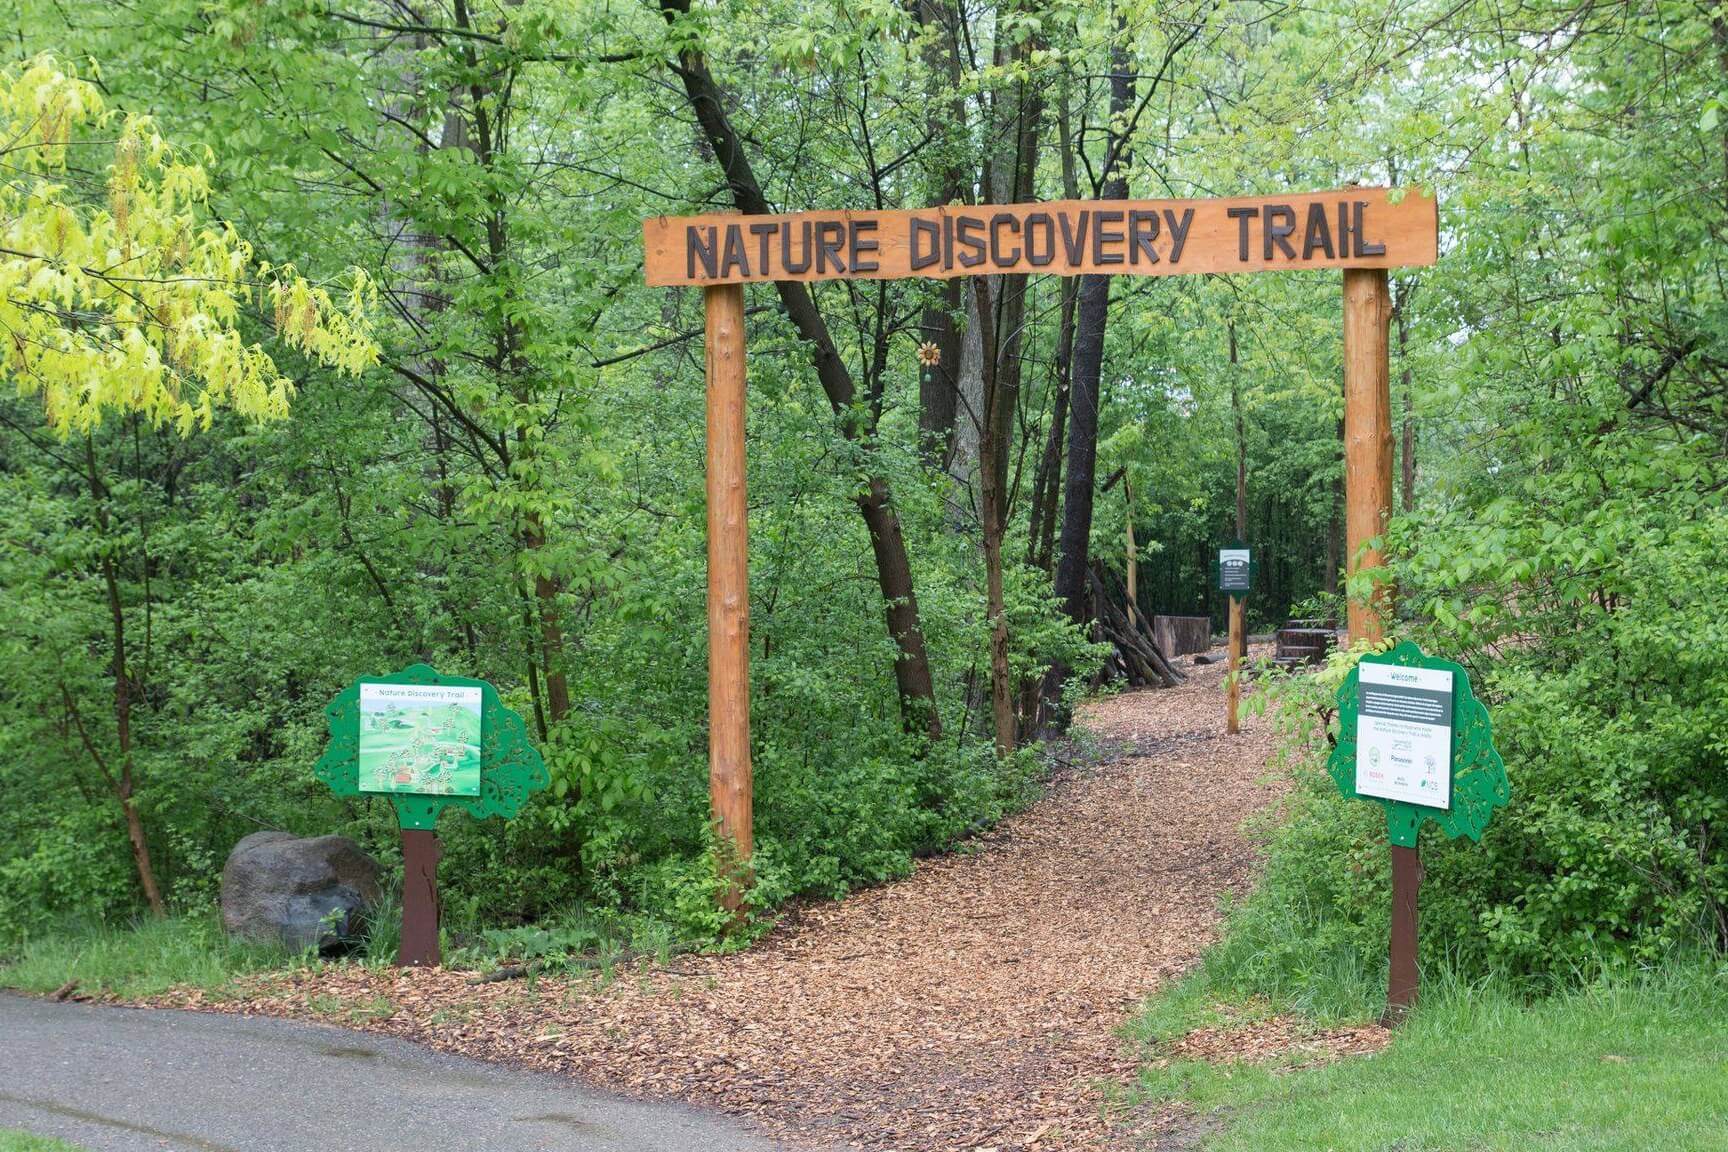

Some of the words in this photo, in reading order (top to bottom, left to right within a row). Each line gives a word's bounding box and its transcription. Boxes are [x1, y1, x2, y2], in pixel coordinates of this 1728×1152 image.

[686, 220, 880, 280] NATURE
[909, 207, 1195, 272] DISCOVERY
[1227, 201, 1386, 262] TRAIL
[1390, 672, 1418, 683] Welcome
[379, 689, 405, 697] Nature
[407, 690, 445, 698] Discovery
